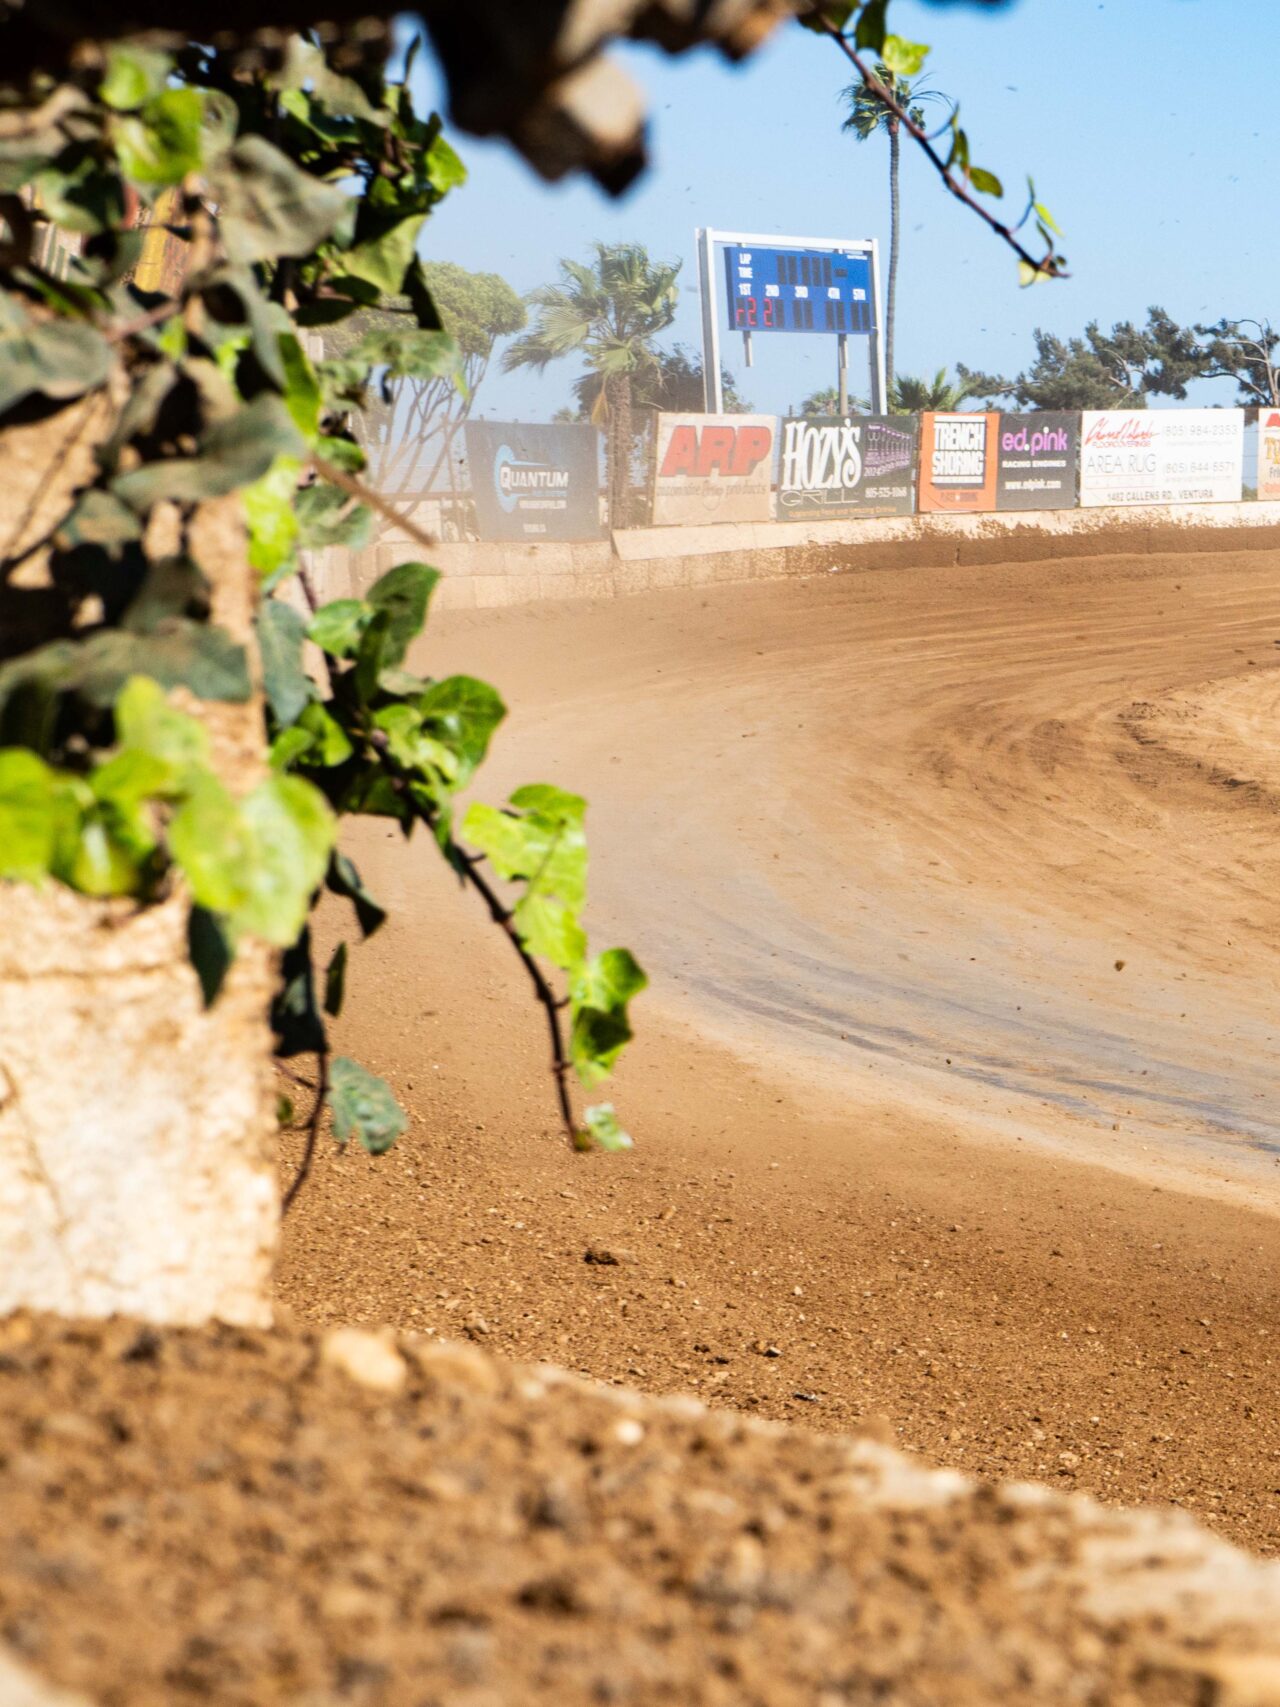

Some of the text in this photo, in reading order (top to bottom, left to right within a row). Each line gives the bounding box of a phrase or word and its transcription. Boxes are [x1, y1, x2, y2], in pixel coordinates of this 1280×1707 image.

[933, 422, 986, 451] TRENCH
[1001, 426, 1068, 457] ed.pink
[660, 425, 772, 478] ARP
[781, 418, 862, 491] HOZY'S
[931, 450, 984, 476] SHORING
[1001, 459, 1067, 468] RACING ENGINES
[1087, 453, 1157, 474] AREA RUG
[500, 466, 569, 490] QUANTUM
[780, 489, 859, 507] GRILL
[1126, 490, 1160, 502] CALLENS
[1178, 488, 1214, 500] VENTURA
